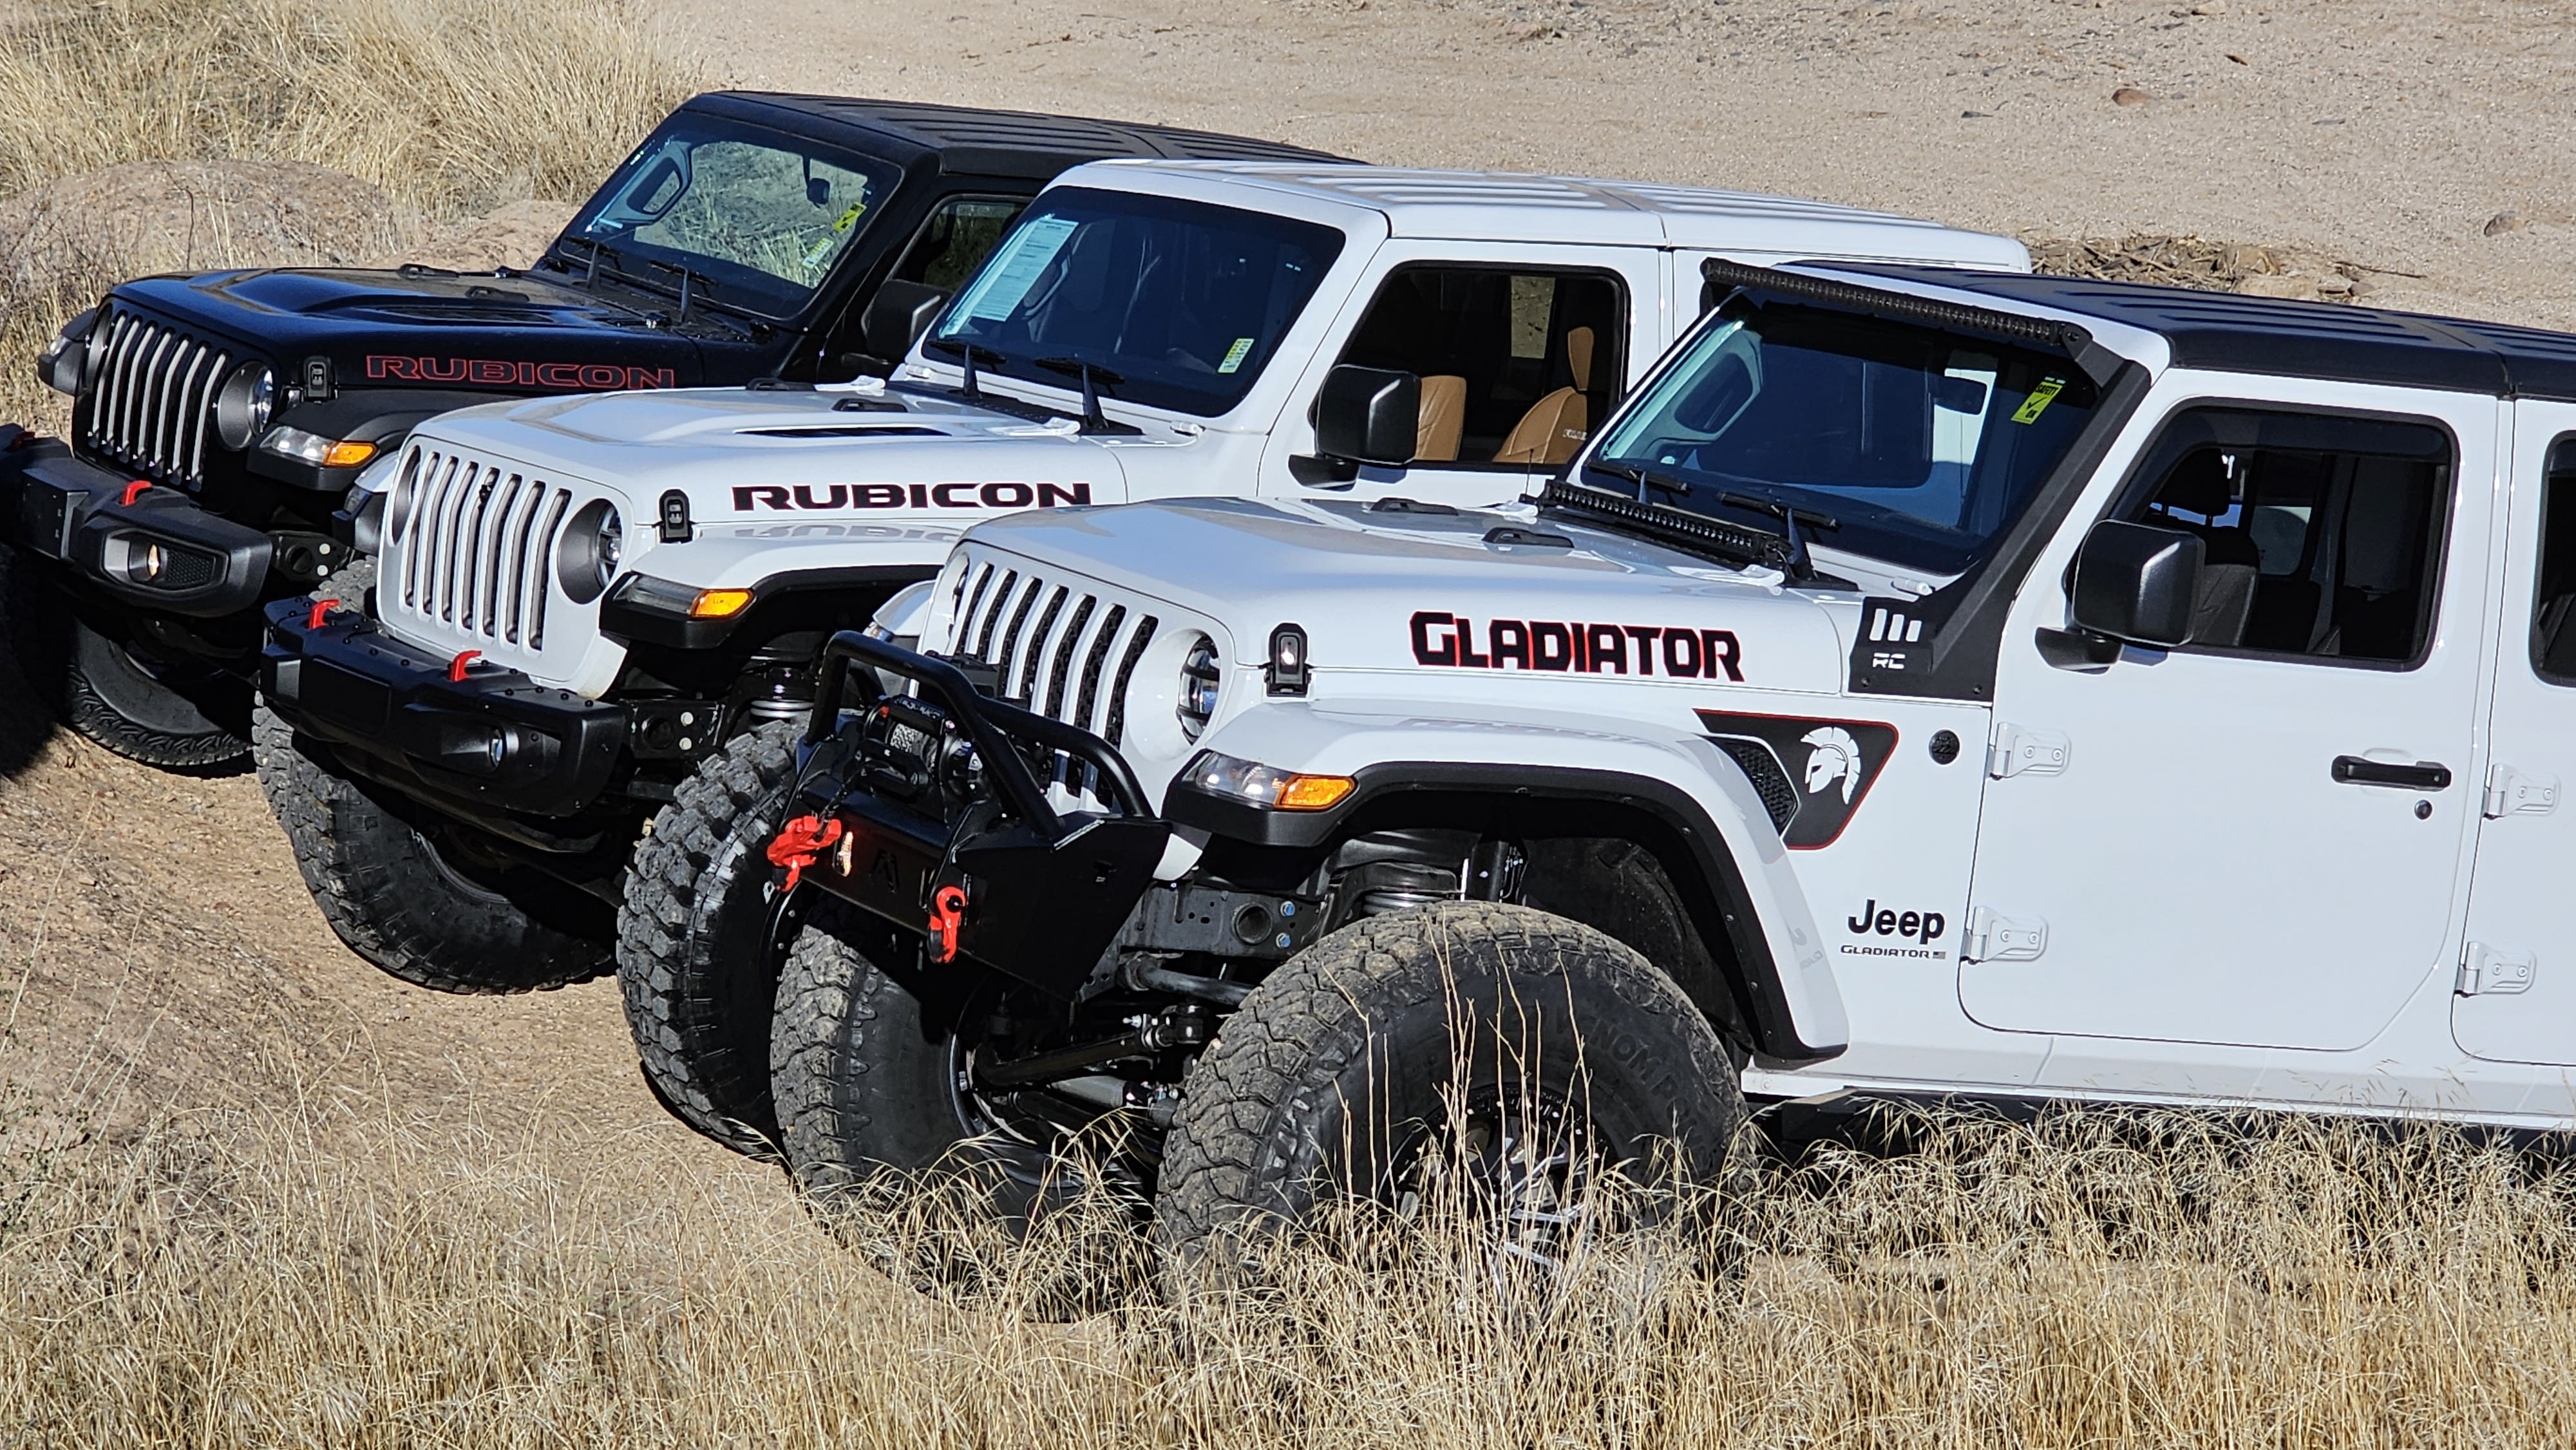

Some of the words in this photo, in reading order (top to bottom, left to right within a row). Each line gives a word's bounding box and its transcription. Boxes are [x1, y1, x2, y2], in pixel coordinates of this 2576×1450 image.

[366, 355, 674, 389] RUBICON
[732, 483, 1091, 511] RUBICON
[1410, 611, 1745, 683] GLADIATOR
[1872, 652, 1906, 669] RC
[1848, 899, 1945, 945] Jeep
[1841, 945, 1929, 959] GLADIATOR
